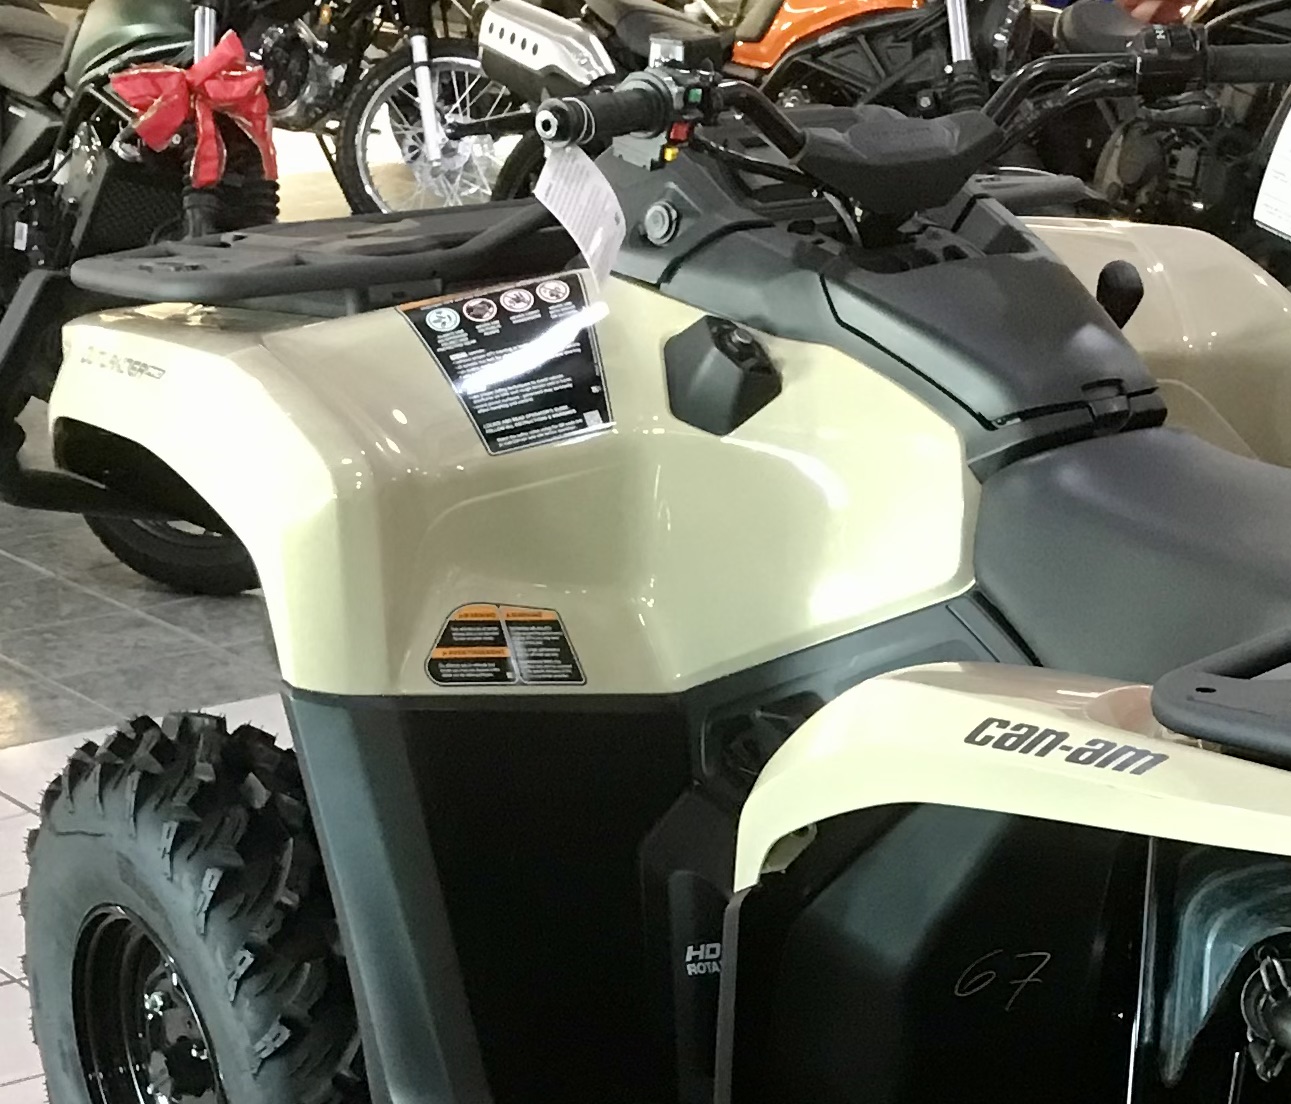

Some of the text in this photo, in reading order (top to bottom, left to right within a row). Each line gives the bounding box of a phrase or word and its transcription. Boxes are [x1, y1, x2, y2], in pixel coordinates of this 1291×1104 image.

[963, 716, 1170, 776] can-am
[686, 961, 721, 976] ROTA
[954, 949, 1052, 1012] 67
